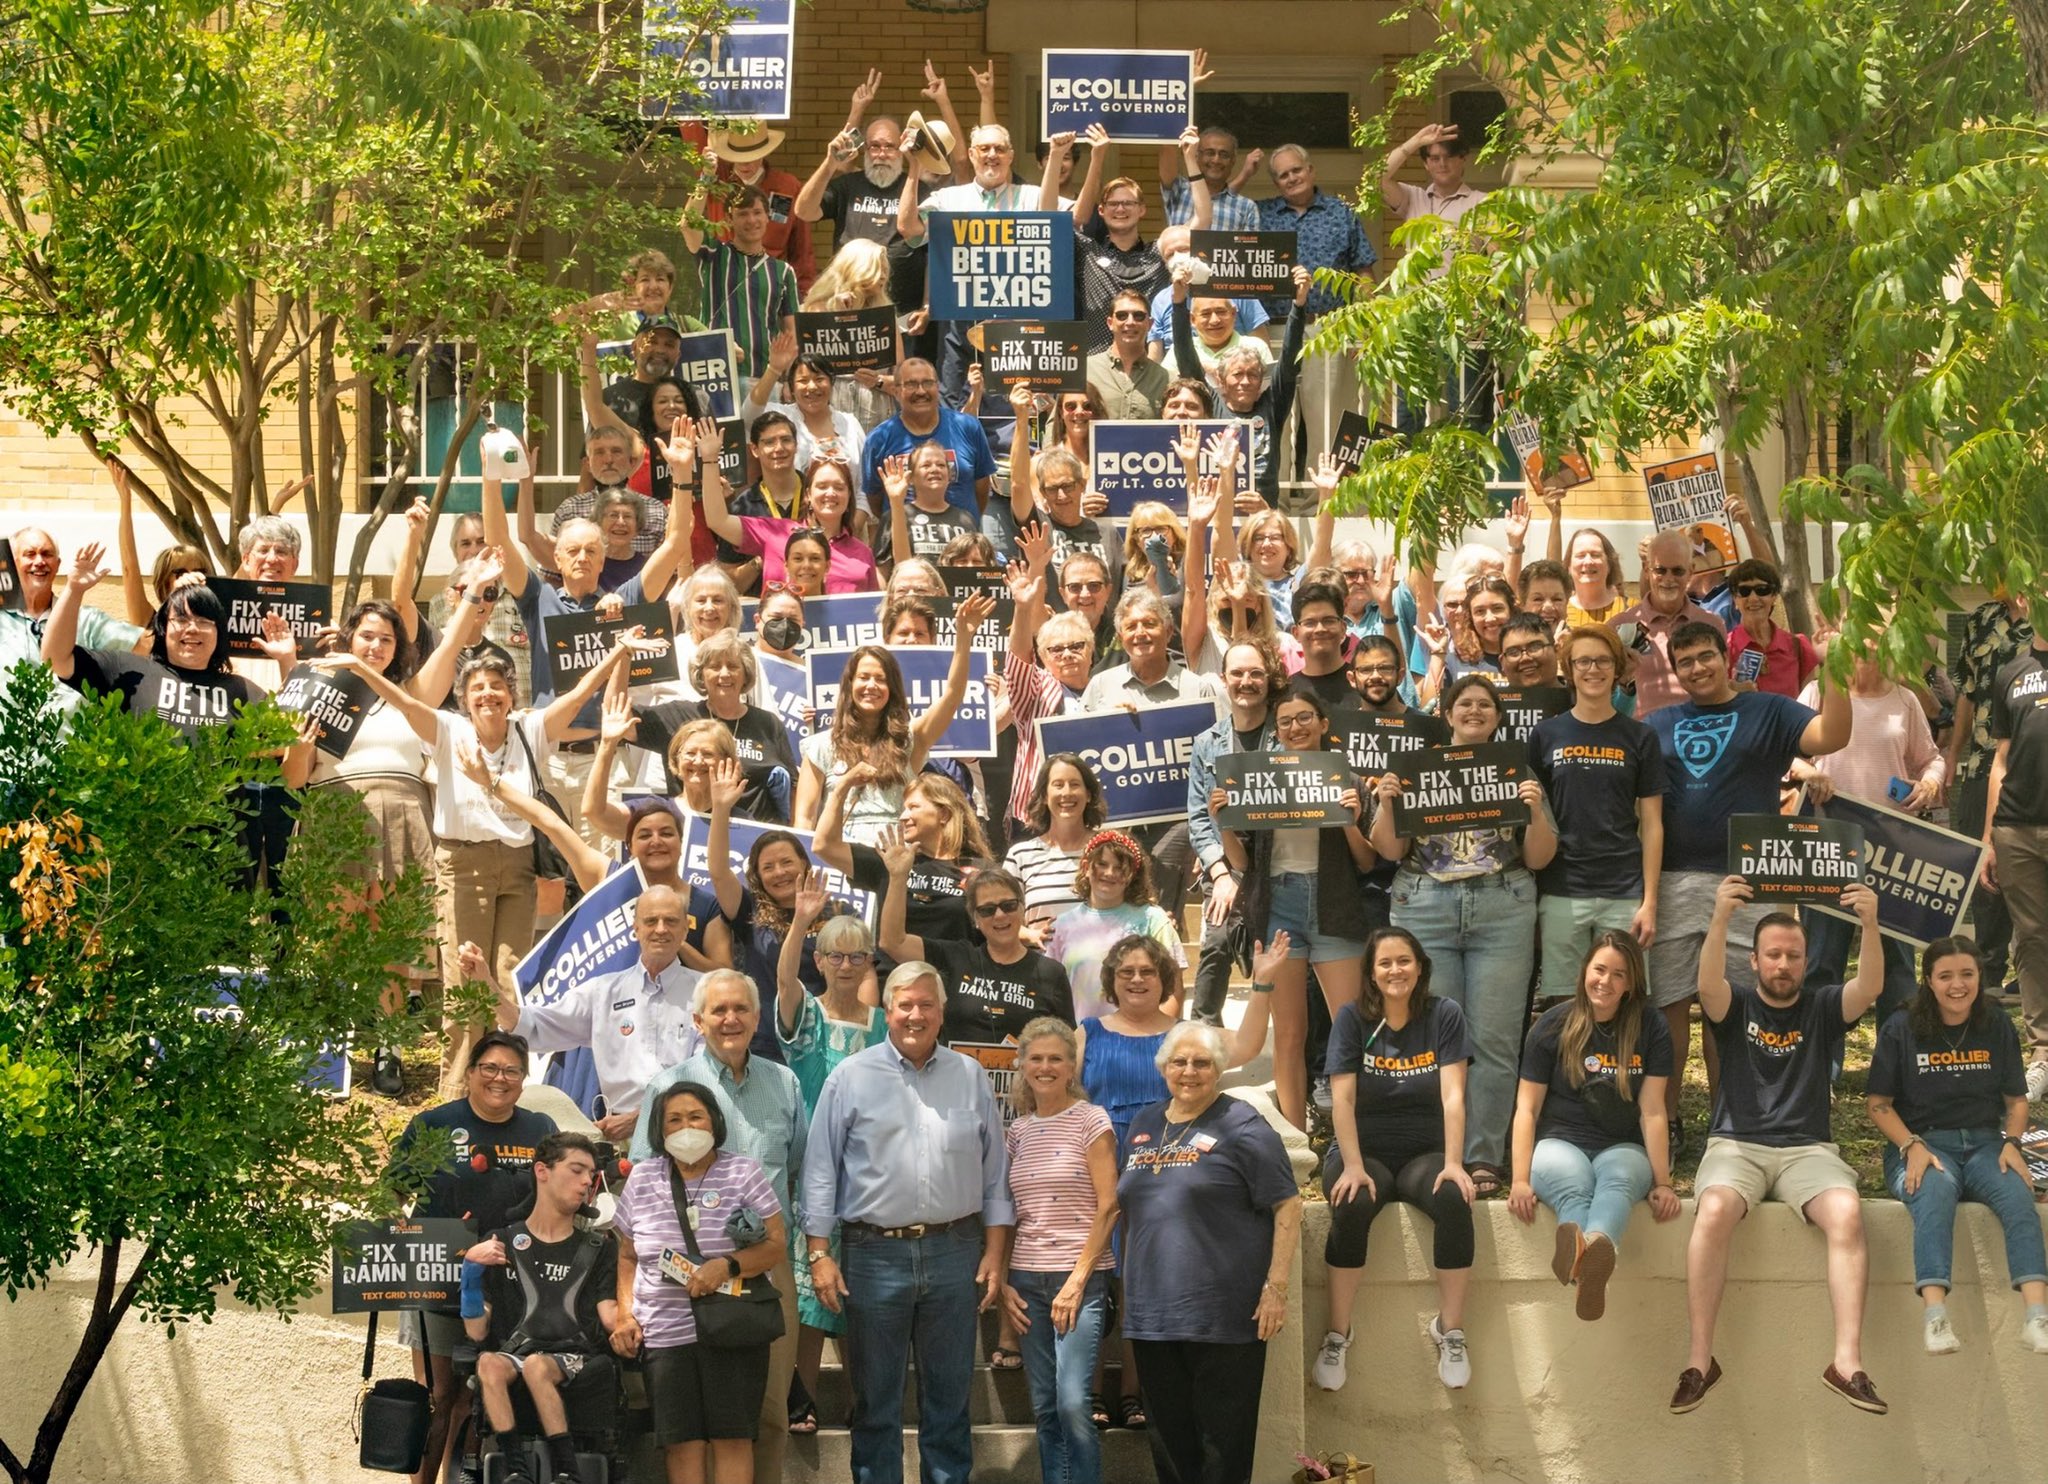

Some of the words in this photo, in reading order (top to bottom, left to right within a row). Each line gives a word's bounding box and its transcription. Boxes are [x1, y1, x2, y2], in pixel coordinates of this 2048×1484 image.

[680, 57, 785, 78] OLLIER
[1072, 78, 1187, 100] COLLIER
[1050, 102, 1069, 113] for
[1073, 102, 1093, 112] LT.
[1101, 103, 1187, 113] GOVERNOR
[952, 219, 1014, 245] VOTE
[1017, 225, 1039, 238] FOR
[1042, 225, 1051, 238] A
[952, 247, 1051, 274] BETTER
[1213, 249, 1239, 263] FIX
[1245, 250, 1275, 264] THE
[1209, 264, 1245, 278] AMN
[1251, 264, 1289, 278] GRID
[952, 275, 1051, 307] TEXAS
[816, 329, 841, 342] FIX
[847, 325, 877, 341] THE
[855, 337, 890, 355] GRID
[1001, 340, 1024, 356] FIX
[1031, 340, 1063, 356] THE
[991, 356, 1031, 372] DAMN
[1038, 356, 1079, 371] GRID
[1099, 478, 1118, 490] for
[1123, 478, 1144, 488] LT.
[1651, 482, 1677, 504] MIKE
[1678, 473, 1719, 498] COLLIER
[1656, 499, 1690, 525] RURAL
[1690, 492, 1724, 517] TEXAS
[232, 600, 262, 618] FIX
[574, 632, 606, 651] FIX
[2024, 671, 2043, 685] FIX
[158, 677, 228, 717] BETO
[312, 681, 348, 711] THE
[2013, 680, 2047, 699] DAMN
[171, 713, 186, 724] FOR
[310, 699, 354, 733] GRID
[1349, 732, 1380, 751] FIX
[1690, 740, 1711, 758] D
[1079, 737, 1193, 774] COLLIE
[1563, 745, 1625, 760] COLLIER
[1577, 757, 1625, 767] GOVERNOR
[1244, 771, 1277, 788] FIX
[1285, 770, 1323, 787] THE
[1420, 770, 1453, 789] FIX
[1459, 765, 1499, 785] THE
[1227, 787, 1287, 807] DAMN
[1295, 786, 1342, 804] GRID
[1403, 787, 1463, 809] DAMN
[1470, 782, 1518, 803] GRID
[1247, 812, 1266, 820] TEXT
[1302, 810, 1325, 818] 43100
[1424, 815, 1444, 823] TEXT
[1445, 813, 1465, 821] GRID
[1479, 809, 1502, 817] 43100
[1761, 839, 1794, 857] FIX
[1802, 841, 1841, 859] THE
[1741, 857, 1803, 876] DAMN
[1811, 859, 1858, 878] GRID
[931, 876, 955, 888] THE
[1782, 884, 1802, 892] GRID
[1864, 874, 1957, 916] OVERNOR
[959, 981, 999, 1001] DAMN
[1003, 992, 1035, 1010] GRID
[1000, 981, 1025, 996] THE
[1375, 1051, 1435, 1070] COLLIER
[1930, 1050, 1990, 1064] COLLIER
[1390, 1064, 1438, 1077] GOVERNOR
[1135, 1151, 1200, 1164] COLLIER
[362, 1243, 397, 1263] FIX
[405, 1243, 447, 1262] THE
[343, 1263, 406, 1284] DAMN
[362, 1292, 383, 1300] TEXT
[385, 1291, 406, 1299] GRID
[409, 1291, 421, 1299] TO
[422, 1290, 447, 1299] 43100
